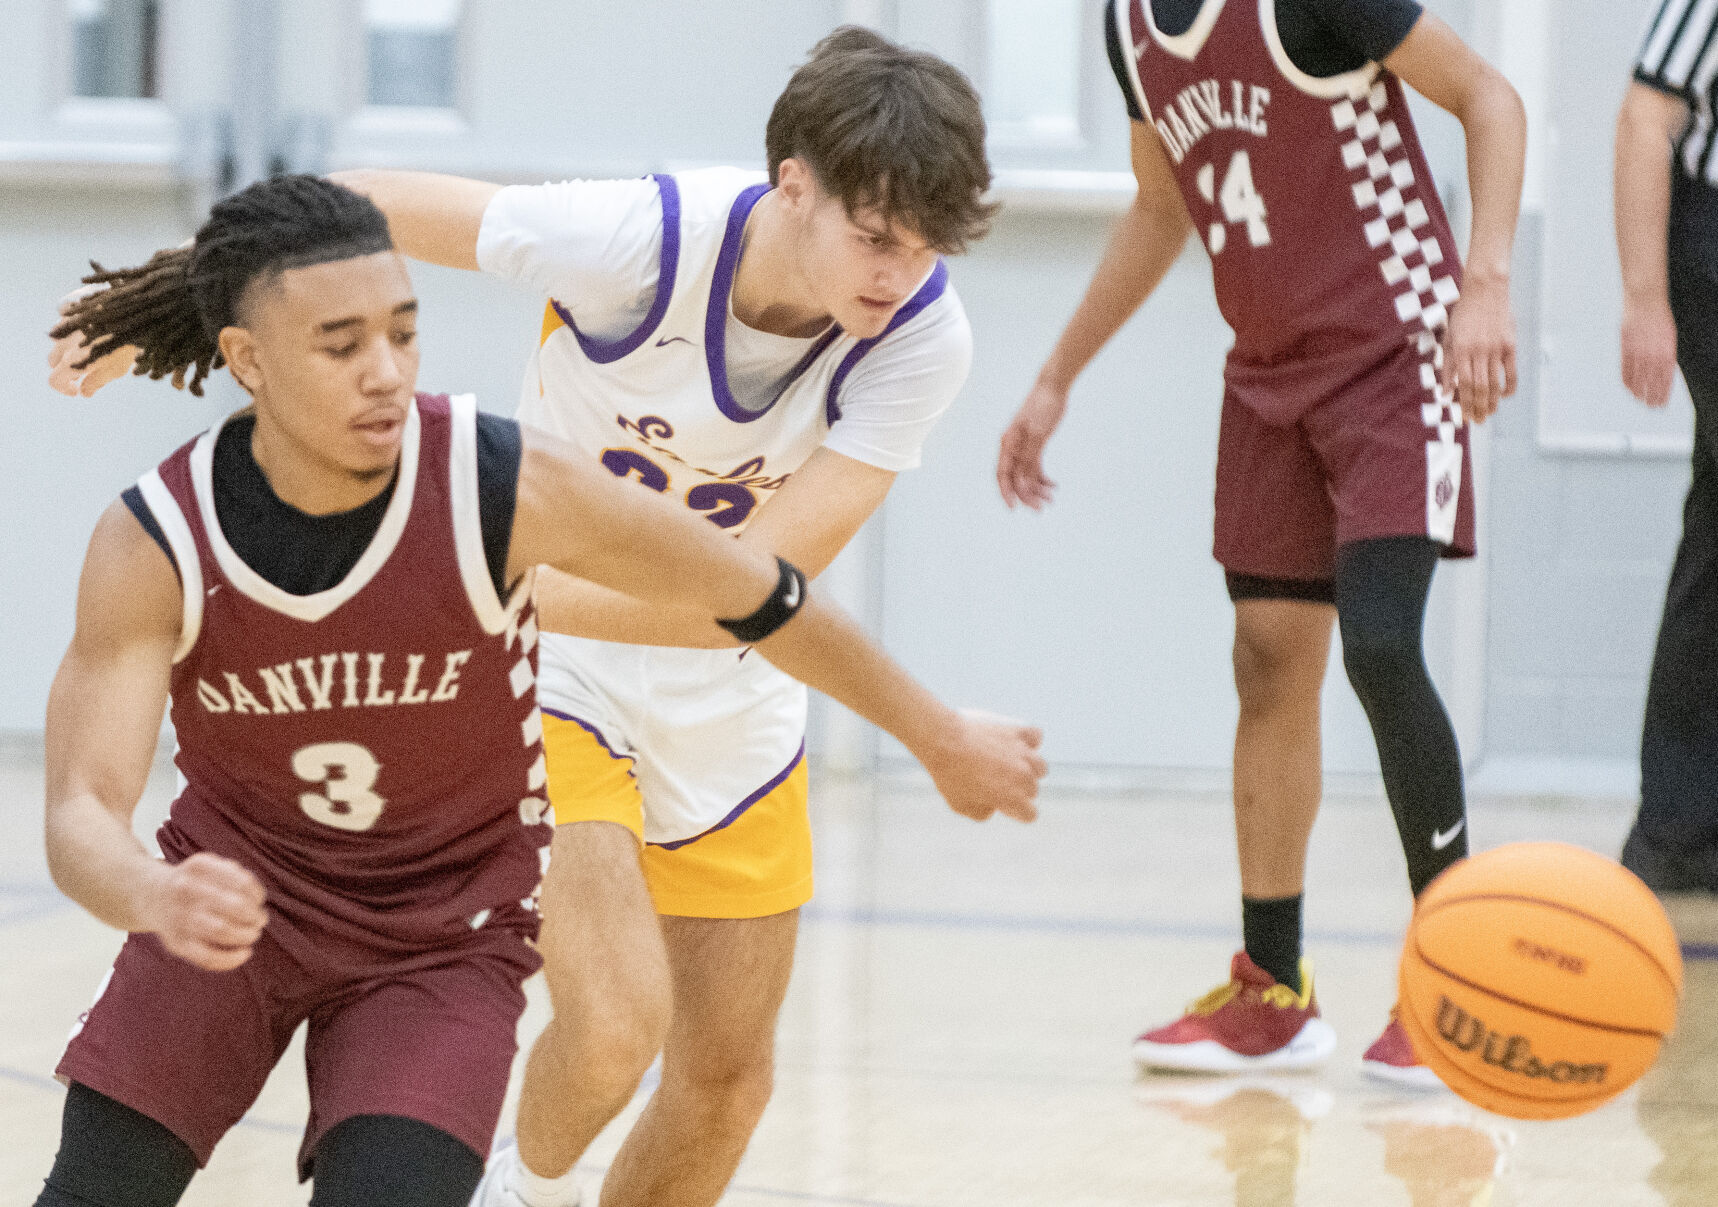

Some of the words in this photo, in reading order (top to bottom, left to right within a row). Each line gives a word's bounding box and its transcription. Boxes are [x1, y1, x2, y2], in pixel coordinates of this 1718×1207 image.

[198, 649, 473, 715] DANVILLE
[291, 741, 388, 832] 3
[1434, 994, 1609, 1084] Wilson
